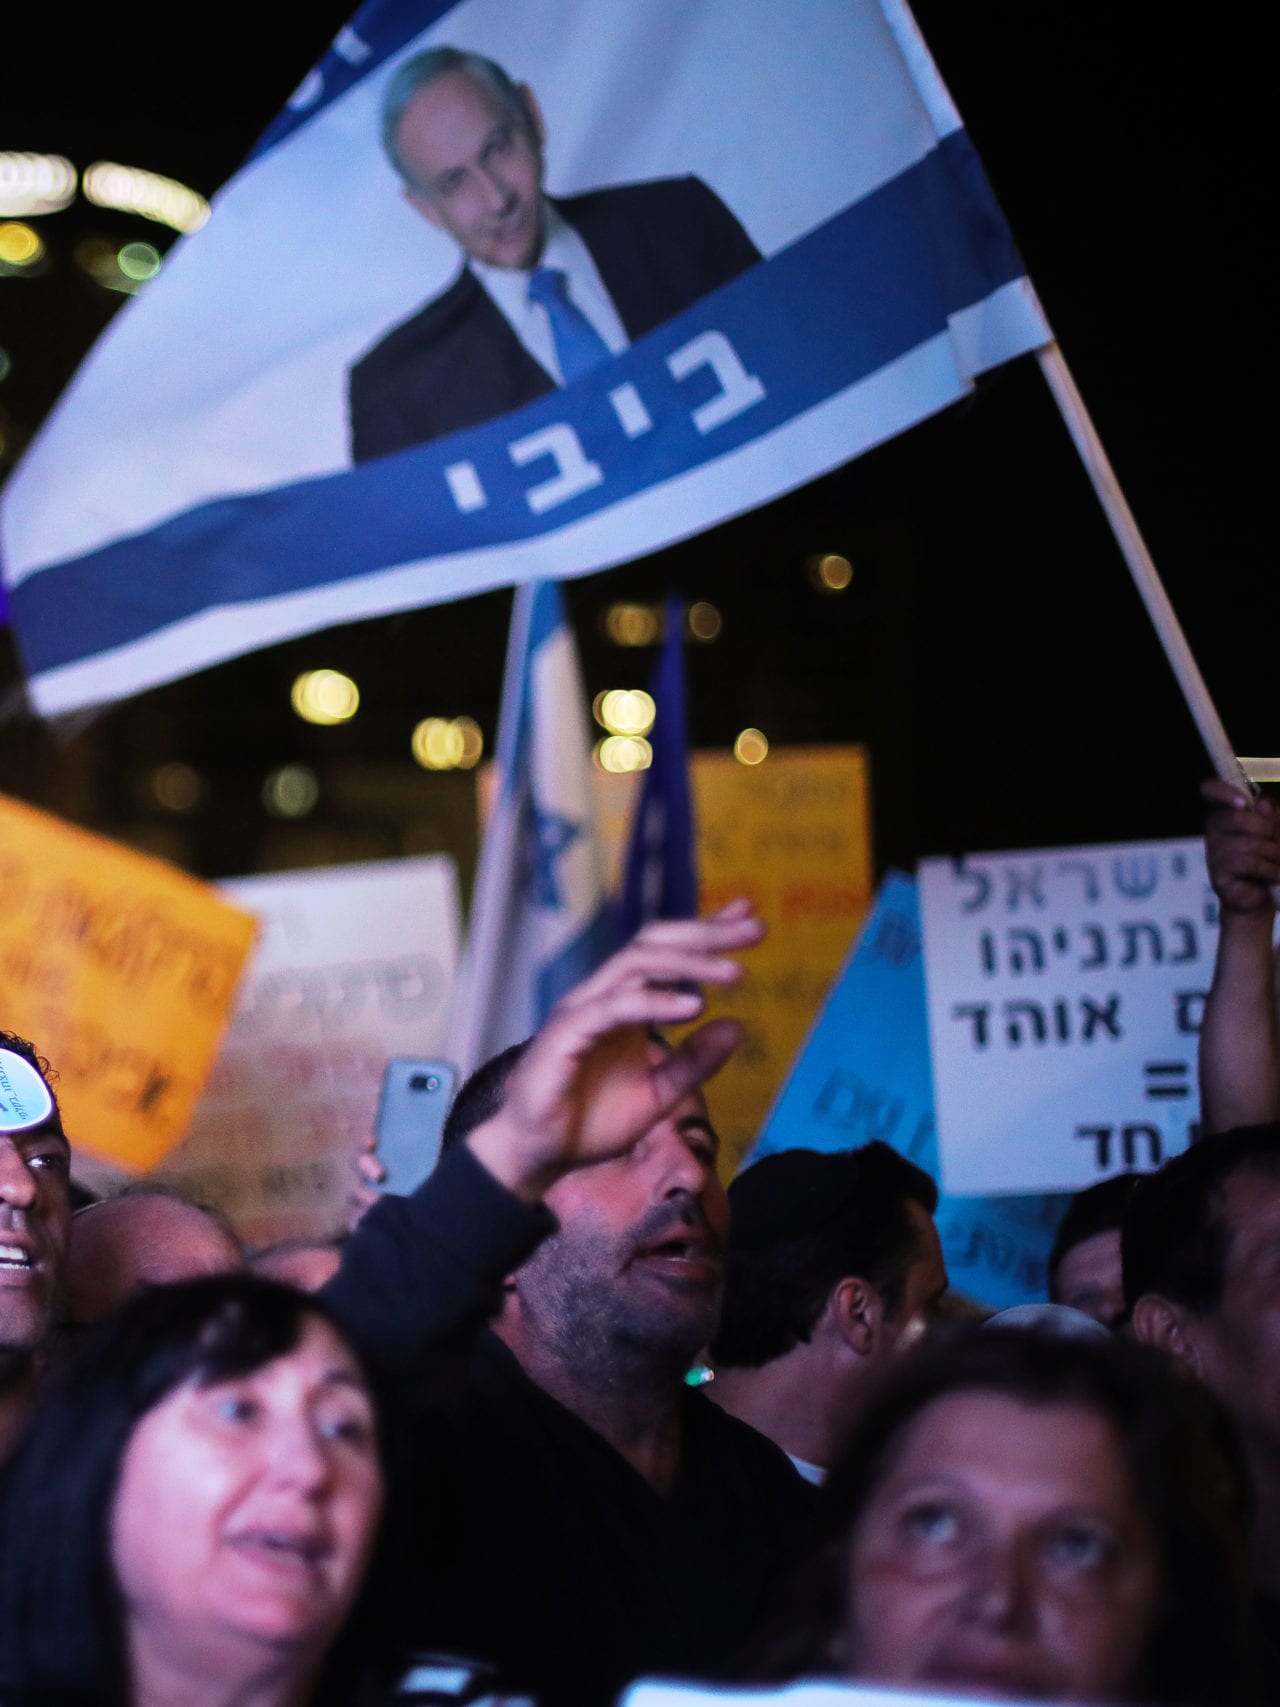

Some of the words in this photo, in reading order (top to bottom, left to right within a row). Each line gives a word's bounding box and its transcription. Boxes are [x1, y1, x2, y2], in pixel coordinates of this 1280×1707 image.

[445, 329, 766, 515] ביבי
[954, 853, 1187, 914] ישראל
[981, 905, 1219, 976] נתניהו
[951, 991, 1122, 1051] אוהד
[1174, 988, 1209, 1037] ם
[1074, 1119, 1201, 1171] חד
